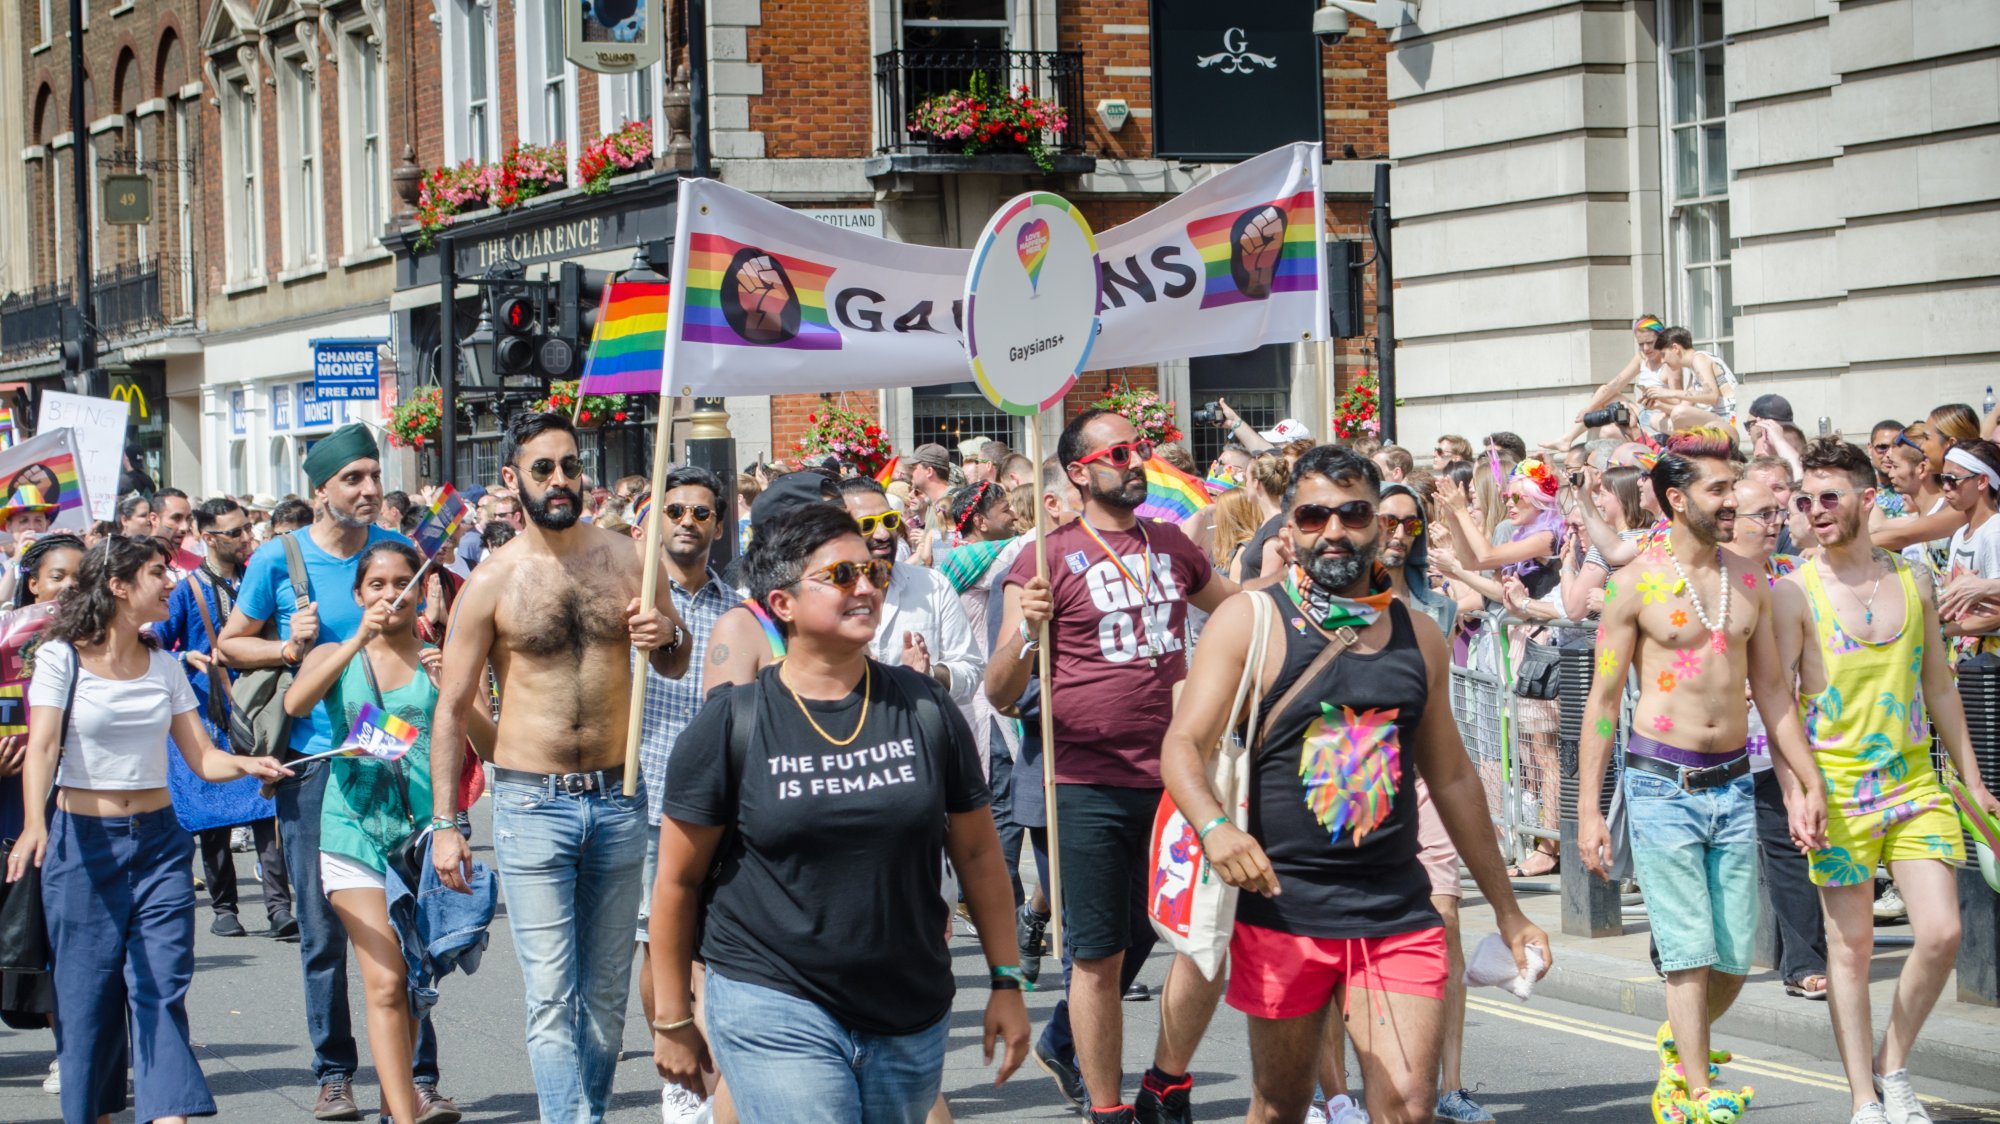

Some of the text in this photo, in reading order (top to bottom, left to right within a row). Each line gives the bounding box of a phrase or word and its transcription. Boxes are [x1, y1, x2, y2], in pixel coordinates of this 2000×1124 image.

[1223, 27, 1249, 54] G
[119, 192, 137, 206] 49
[478, 217, 600, 268] THE CLARENCE
[317, 351, 374, 363] CHANGE
[1009, 333, 1065, 362] Gaysians+
[317, 363, 375, 377] MONEY
[318, 386, 349, 398] FREE
[351, 386, 376, 397] ATM
[304, 402, 332, 422] MONEY
[1085, 552, 1181, 613] GAY
[767, 738, 916, 775] THE FUTURE
[779, 764, 916, 800] IS FEMALE
